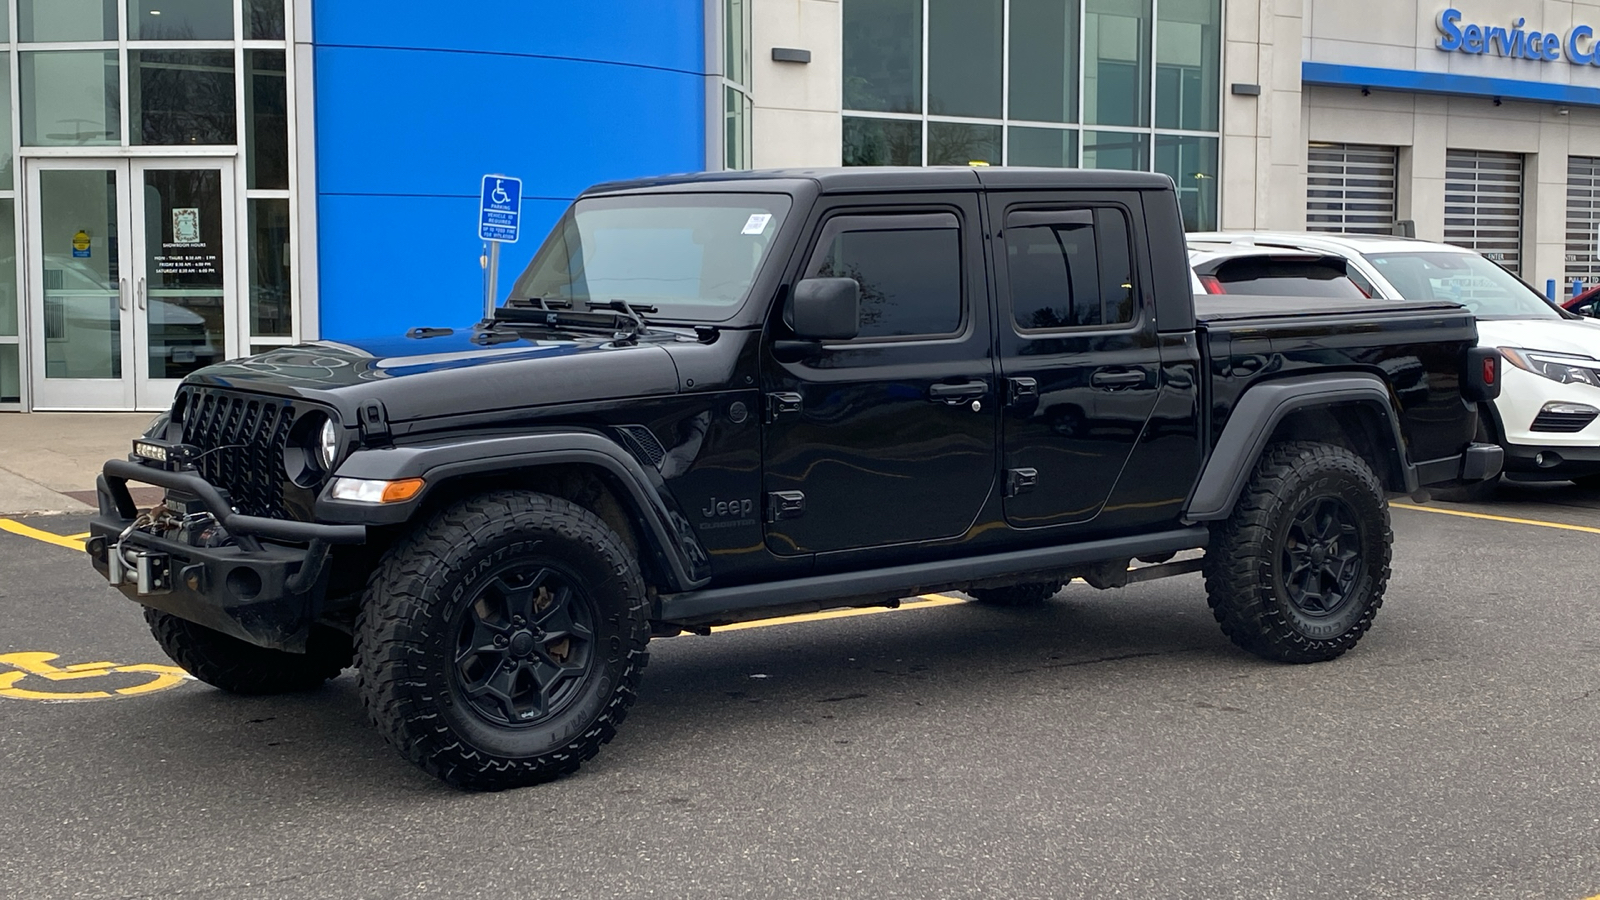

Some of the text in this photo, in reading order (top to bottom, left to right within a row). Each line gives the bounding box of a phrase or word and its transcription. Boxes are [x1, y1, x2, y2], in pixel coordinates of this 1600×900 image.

[1437, 8, 1560, 61] Service
[700, 519, 755, 529] GLADIATOR
[702, 497, 753, 518] Jeep
[442, 540, 544, 623] COUNTRY
